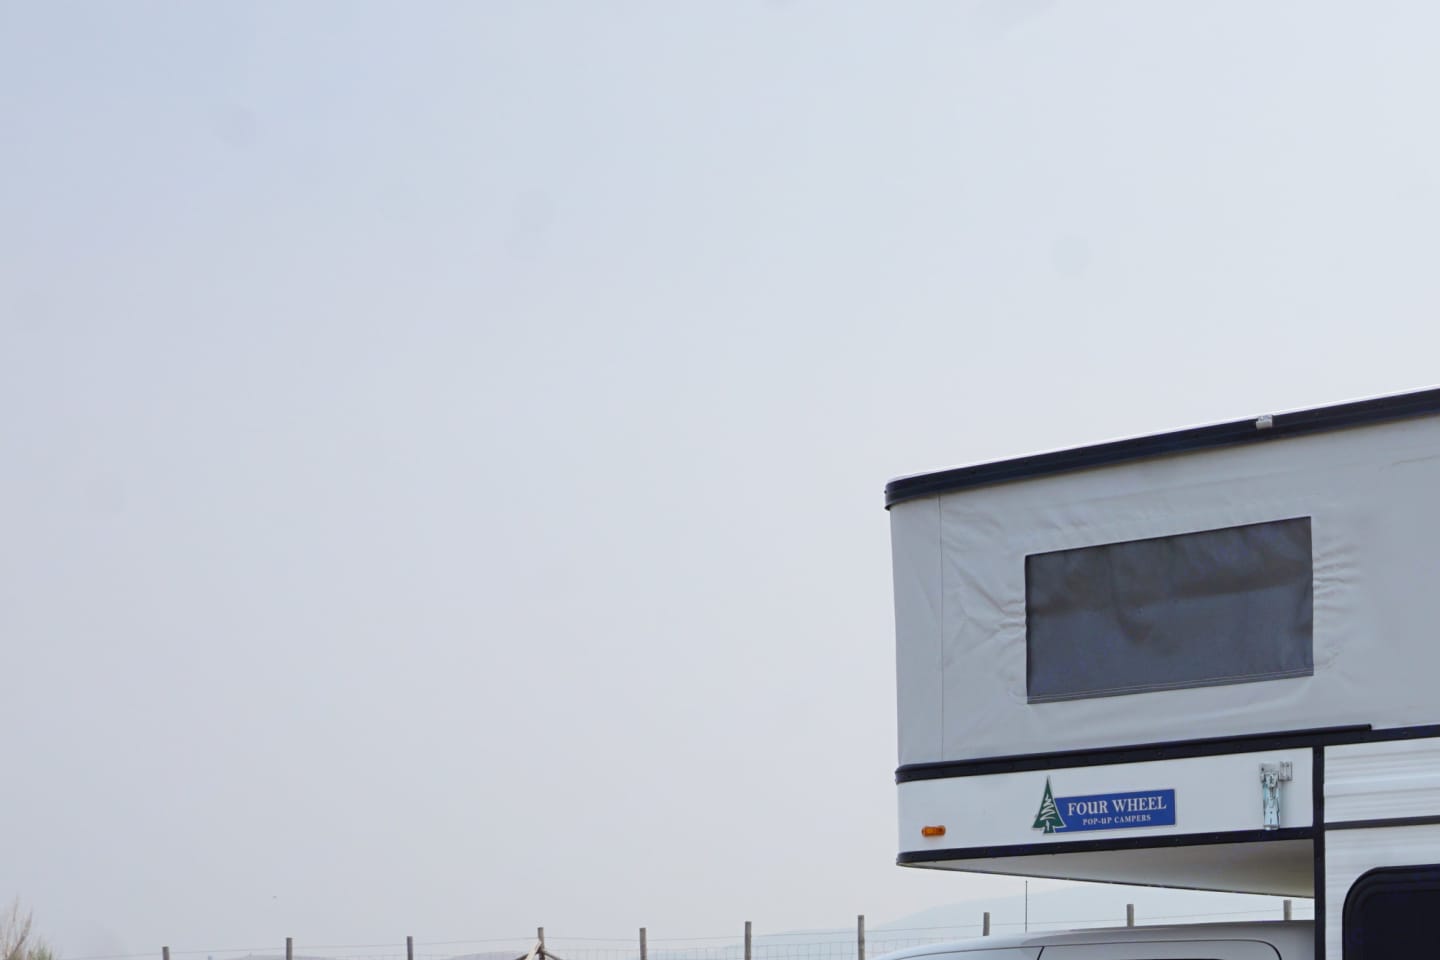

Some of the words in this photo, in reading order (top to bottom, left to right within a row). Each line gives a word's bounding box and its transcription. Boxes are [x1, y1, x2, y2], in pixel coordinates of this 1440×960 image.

[1067, 800, 1109, 816] FOUR
[1111, 796, 1167, 813] WHEEL
[1082, 817, 1112, 826] POP-UP
[1114, 814, 1151, 824] CAMPERS
